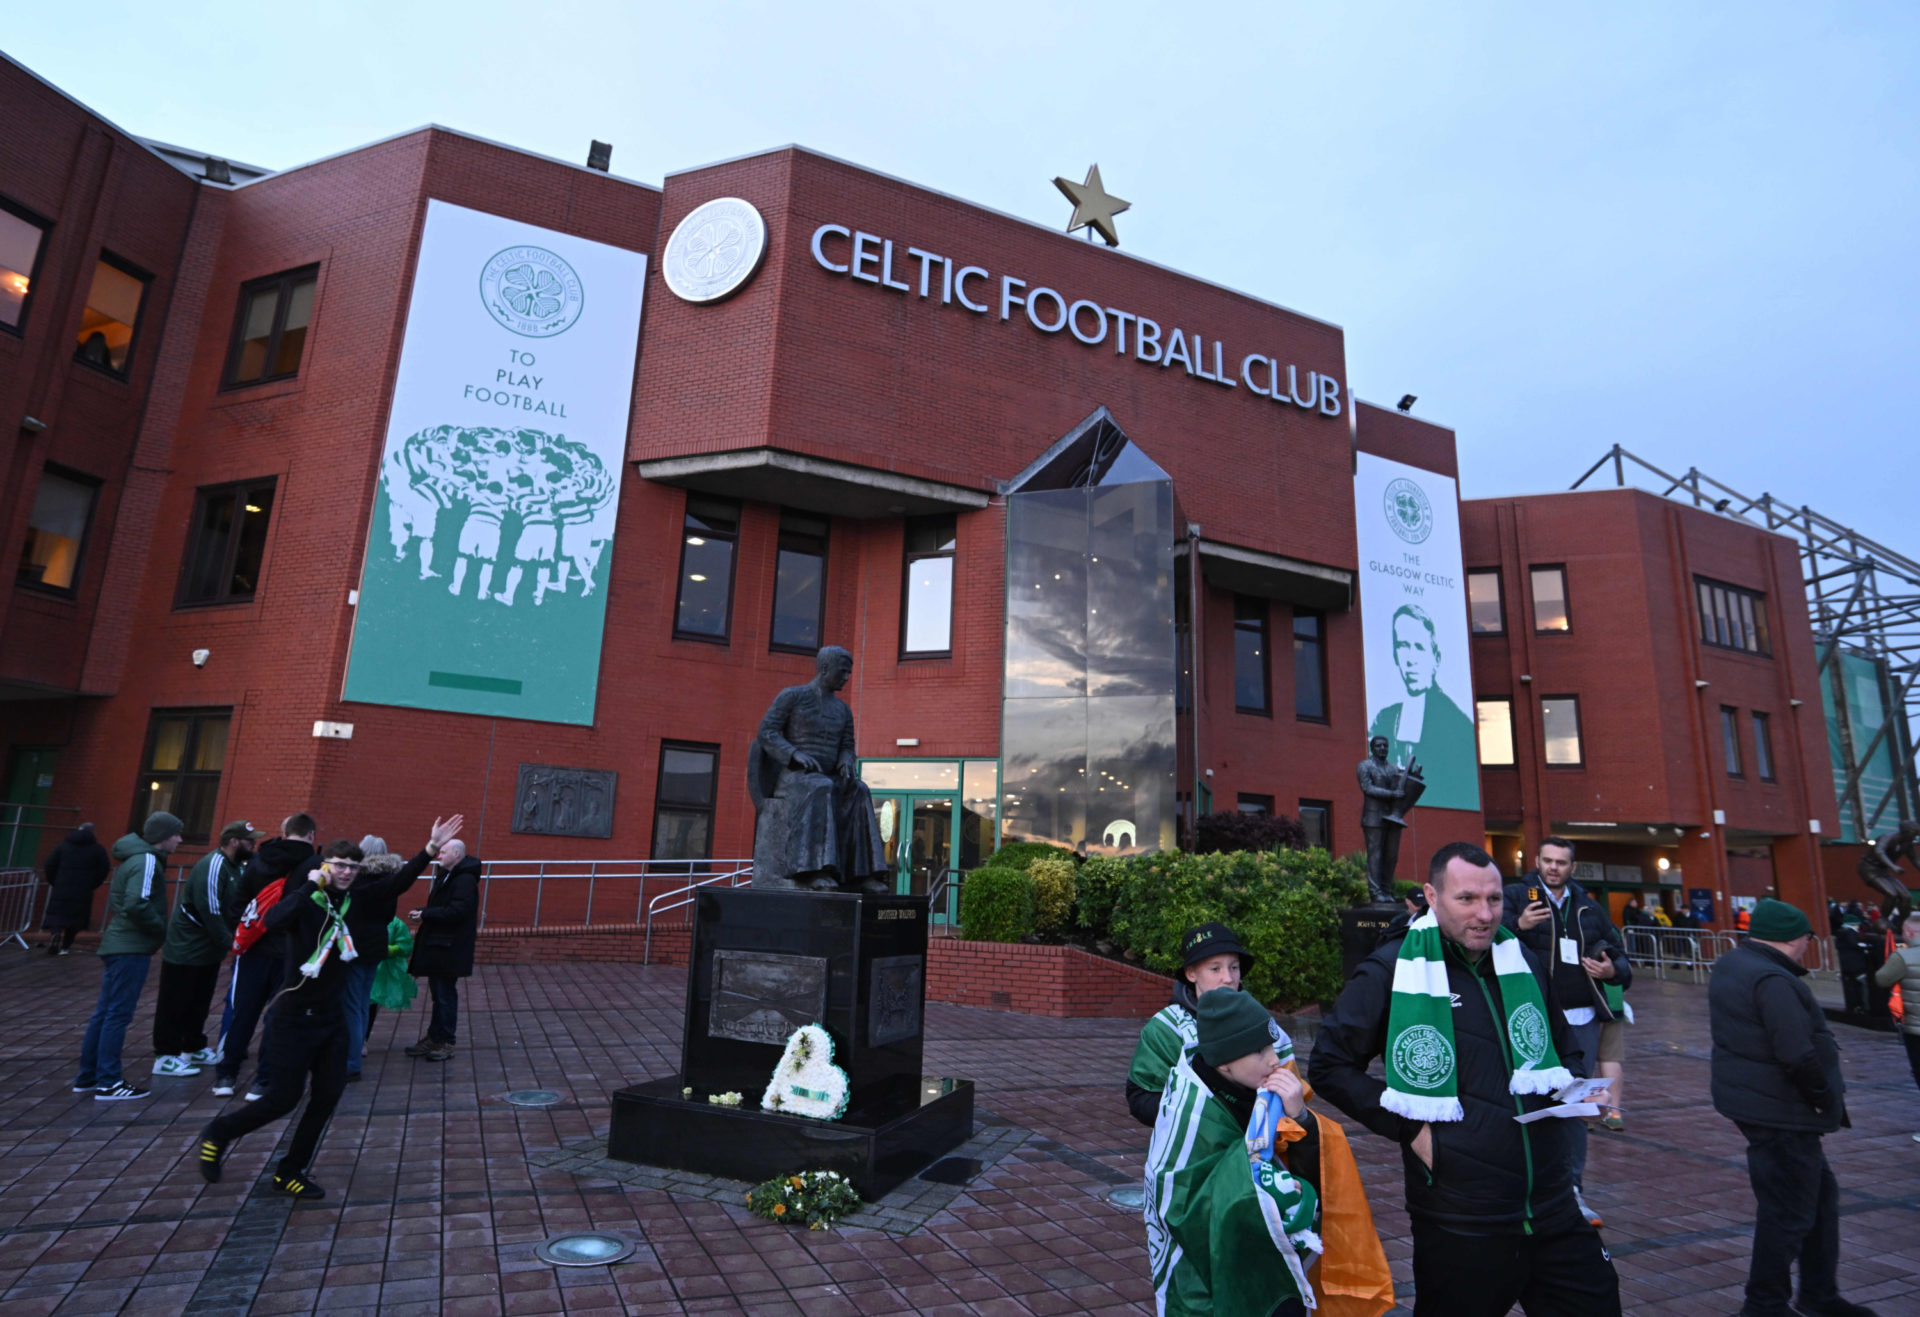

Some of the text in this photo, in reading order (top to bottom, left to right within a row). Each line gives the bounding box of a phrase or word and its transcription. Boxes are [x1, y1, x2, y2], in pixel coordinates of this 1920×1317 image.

[486, 249, 579, 302] THE CELTIC FOOTBALL CLUB
[811, 223, 989, 313] CELTIC
[1000, 275, 1237, 387] FOOTBALL
[1241, 353, 1341, 416] CLUB
[510, 349, 535, 366] TO
[496, 368, 543, 390] PLAY
[464, 384, 567, 418] FOOTBALL
[1403, 552, 1420, 566] THE
[1369, 560, 1455, 589] GLASGOW CELTIC
[1403, 583, 1424, 597] WAY
[1397, 1051, 1405, 1069] THE
[1401, 1030, 1422, 1049] CELTIC
[1440, 1056, 1451, 1075] CLUB
